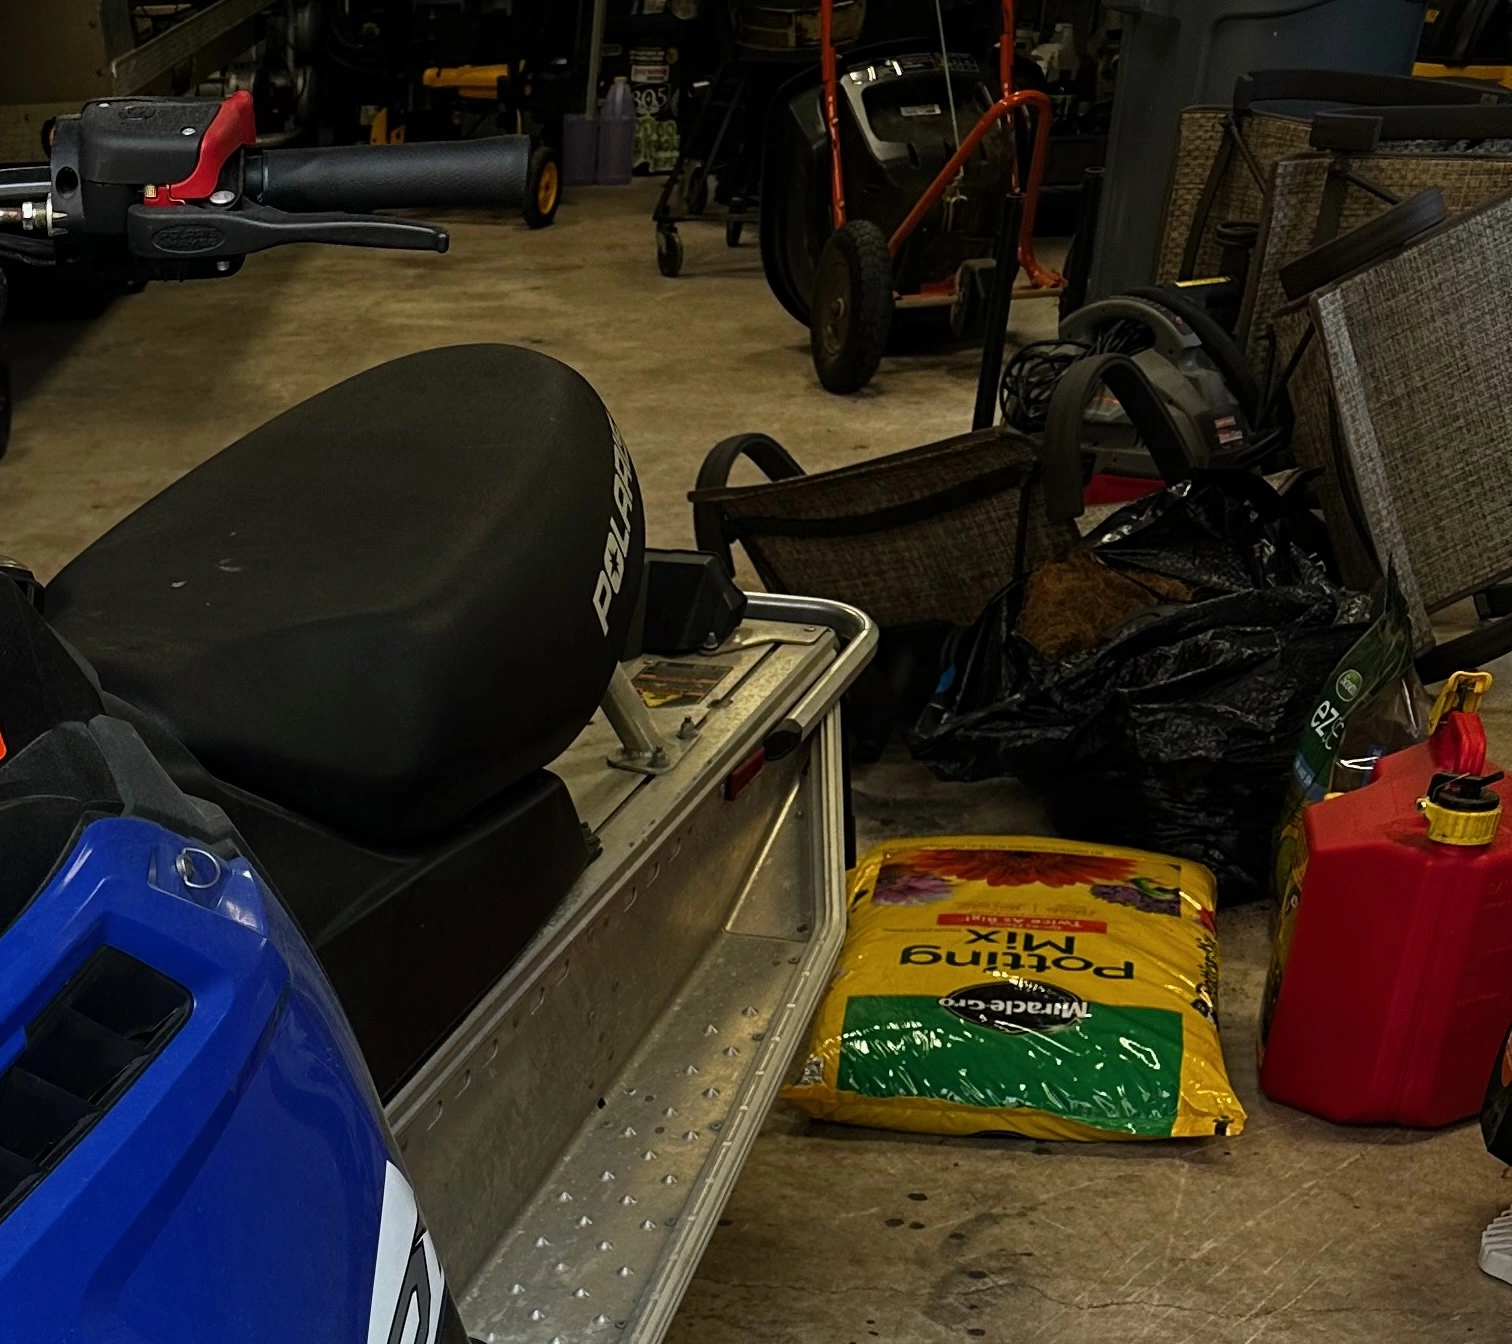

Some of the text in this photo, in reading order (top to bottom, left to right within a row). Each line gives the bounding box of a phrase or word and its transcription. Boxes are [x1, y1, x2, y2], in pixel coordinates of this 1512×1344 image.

[593, 408, 633, 637] POLARI
[1029, 917, 1083, 930] Twice
[964, 928, 1076, 955] Mix
[899, 944, 1135, 980] Potting
